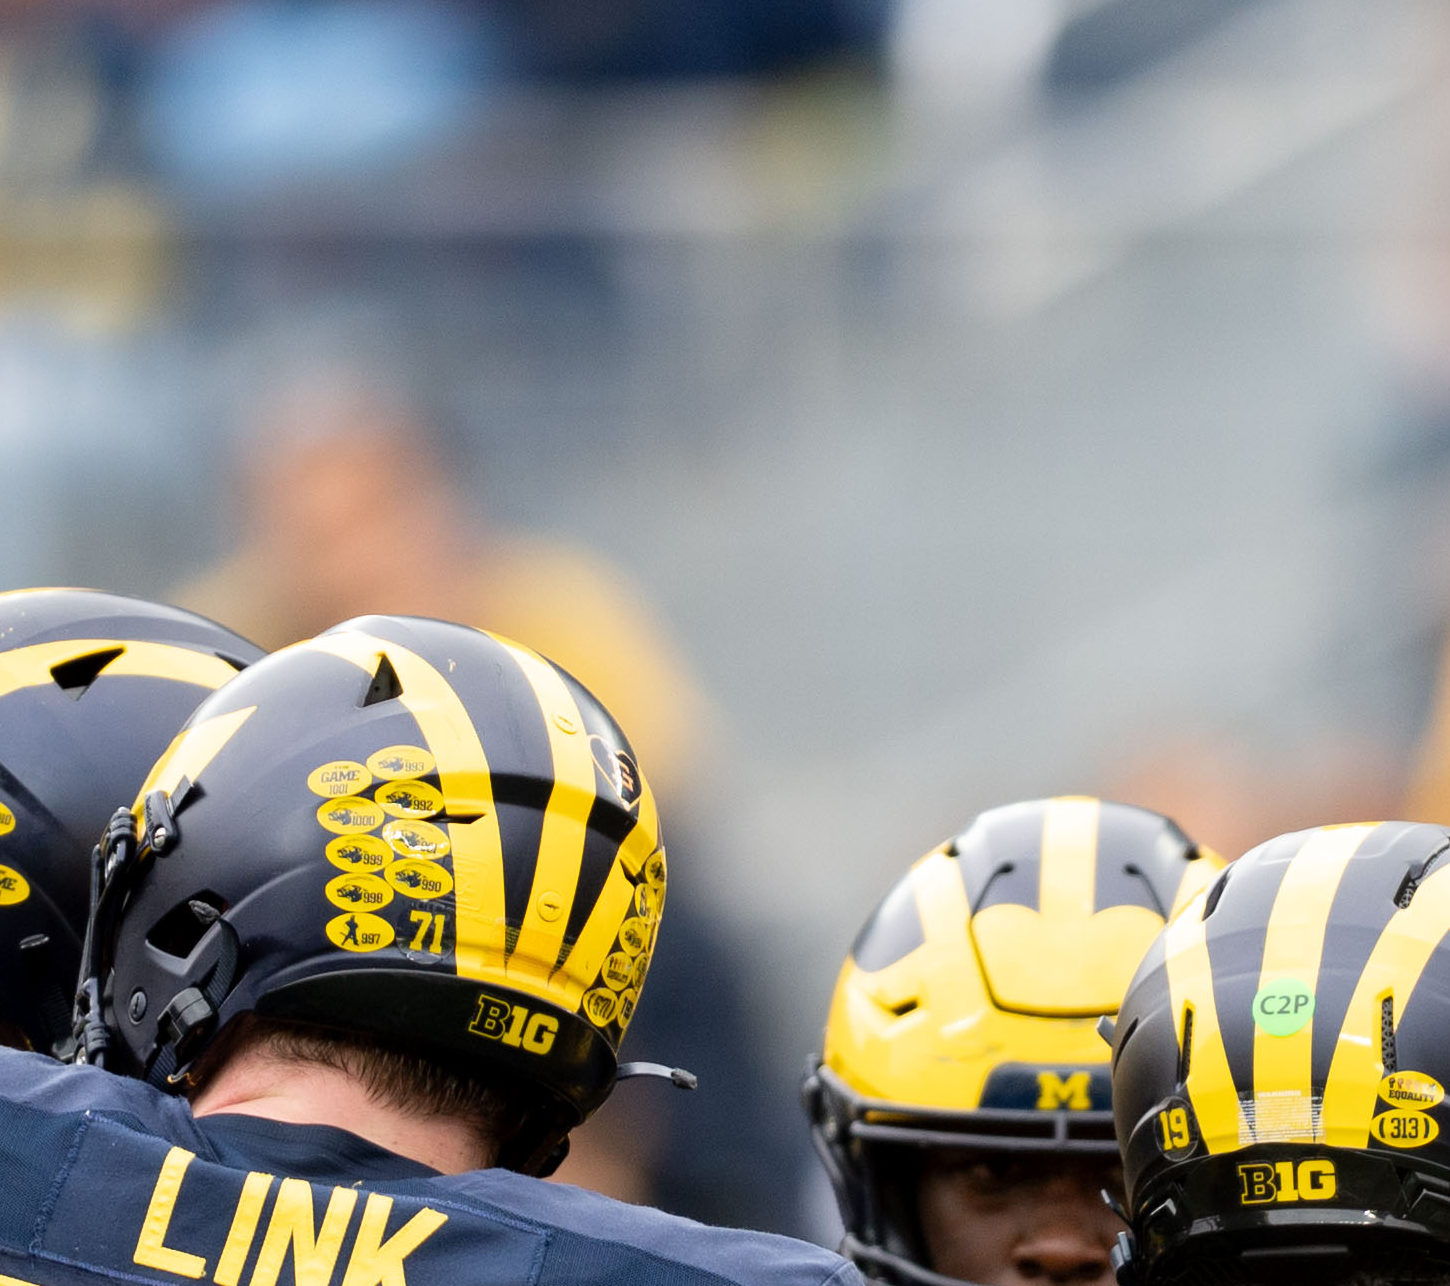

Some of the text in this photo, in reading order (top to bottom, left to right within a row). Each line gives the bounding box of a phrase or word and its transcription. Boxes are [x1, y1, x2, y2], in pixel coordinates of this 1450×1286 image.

[321, 770, 360, 784] GAME
[409, 910, 445, 954] 71
[1259, 993, 1310, 1015] C2P
[1036, 1072, 1092, 1110] M
[1388, 1089, 1435, 1102] EQUALITY
[1159, 1107, 1190, 1150] 19
